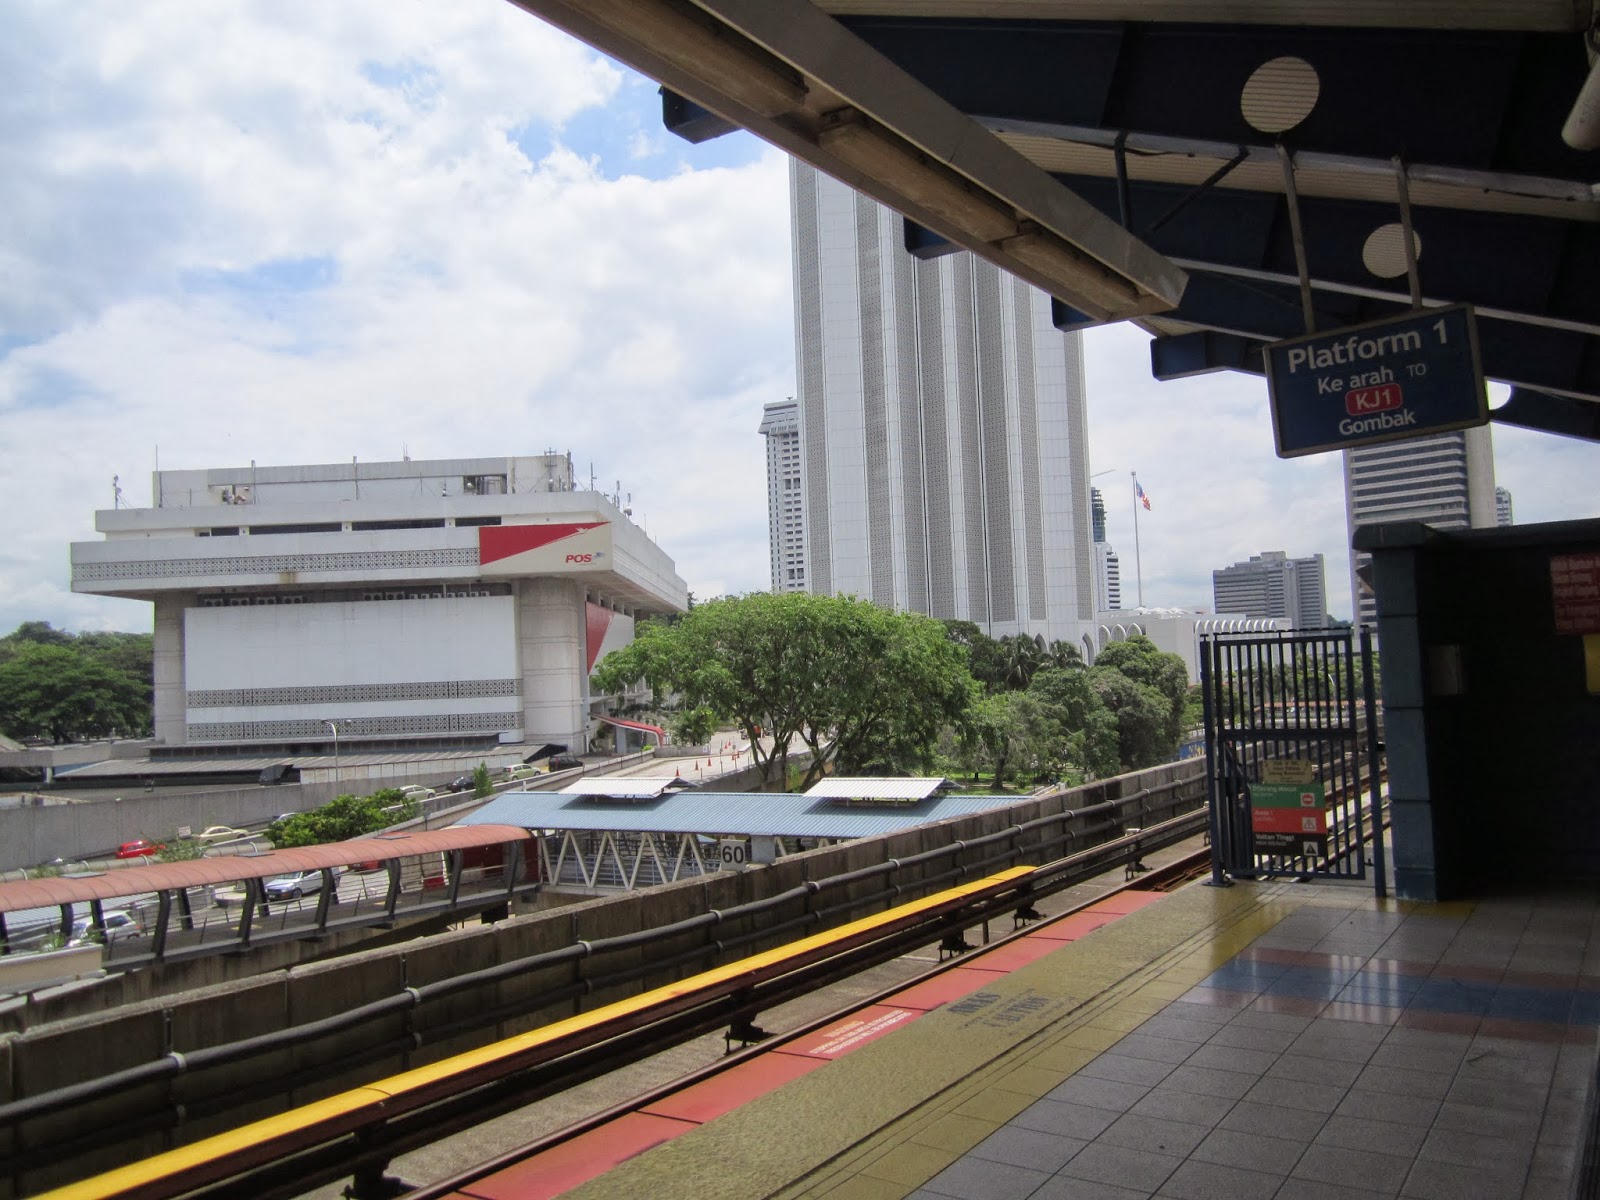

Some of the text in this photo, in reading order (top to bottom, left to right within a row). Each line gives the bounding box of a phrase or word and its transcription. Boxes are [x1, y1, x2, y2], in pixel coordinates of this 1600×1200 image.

[1288, 319, 1449, 374] Platform 1
[1317, 363, 1427, 395] Ke arah TO
[1355, 388, 1393, 411] KJ1
[1338, 408, 1416, 436] Gombak
[565, 553, 592, 564] POS
[722, 845, 744, 863] 60
